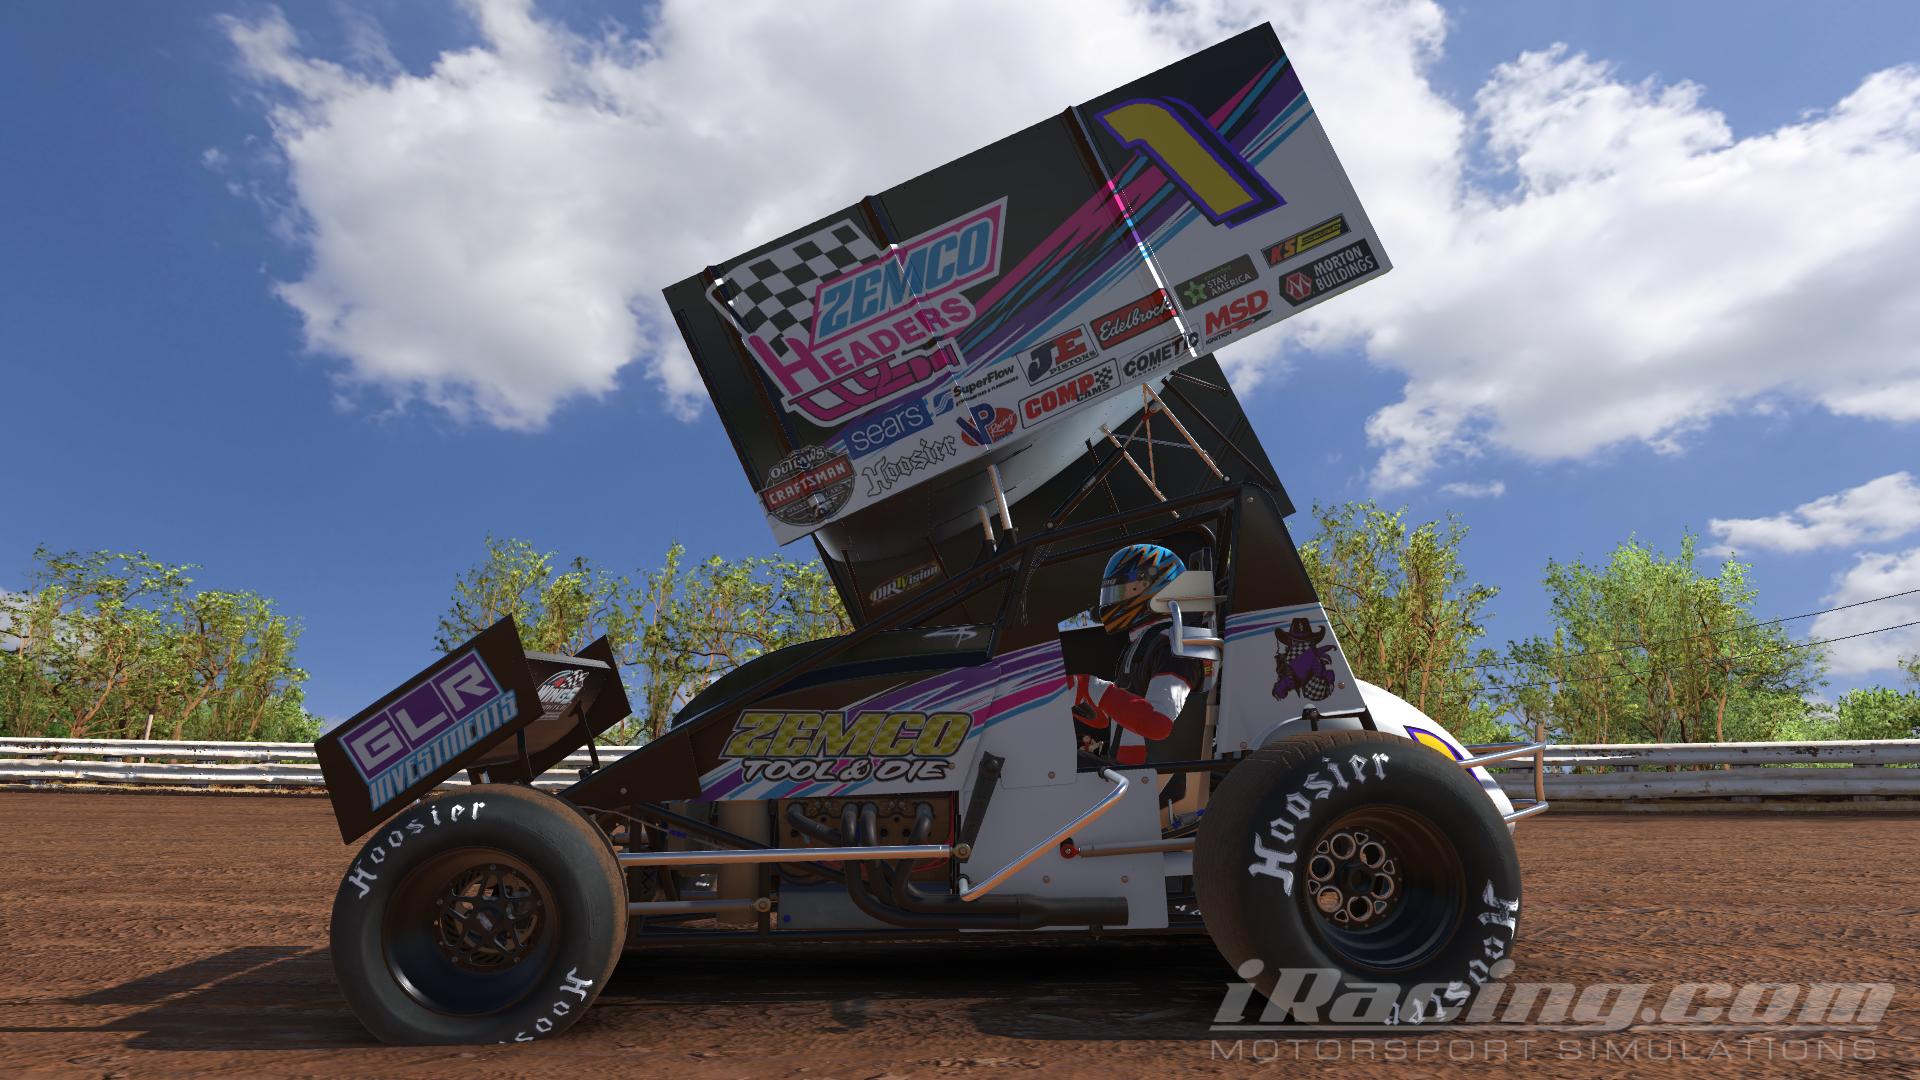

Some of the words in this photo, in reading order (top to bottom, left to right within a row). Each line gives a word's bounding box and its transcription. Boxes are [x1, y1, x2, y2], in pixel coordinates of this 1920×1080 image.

[1094, 96, 1287, 229] 1
[818, 216, 992, 338] ZEMCO
[1206, 272, 1228, 289] STAY
[1313, 245, 1363, 277] MORTON
[1315, 255, 1374, 291] BUILDINGS
[1211, 273, 1252, 296] AMERICA
[1100, 296, 1173, 340] Edelbrock
[1205, 290, 1269, 336] MSD
[748, 297, 972, 397] HEADERS
[1027, 328, 1088, 382] JE
[1050, 351, 1096, 375] PISTONS
[953, 365, 1014, 397] SuperFlow
[1025, 373, 1095, 420] COMP
[1077, 381, 1111, 402] CAMS
[850, 405, 925, 452] sears
[956, 403, 995, 445] VP
[768, 461, 847, 505] CRAFTSMAN
[770, 447, 825, 478] OUTLAWS
[862, 434, 956, 496] Hoosier
[350, 661, 493, 772] GLR
[719, 709, 974, 760] ZEMCO
[369, 690, 517, 811] INVESTMENTS
[742, 758, 838, 781] TOOL
[840, 758, 872, 783] &
[874, 757, 950, 782] DIE
[1248, 752, 1390, 896] Hoosier
[349, 801, 486, 899] Hoosier
[499, 966, 593, 1044] Hoos
